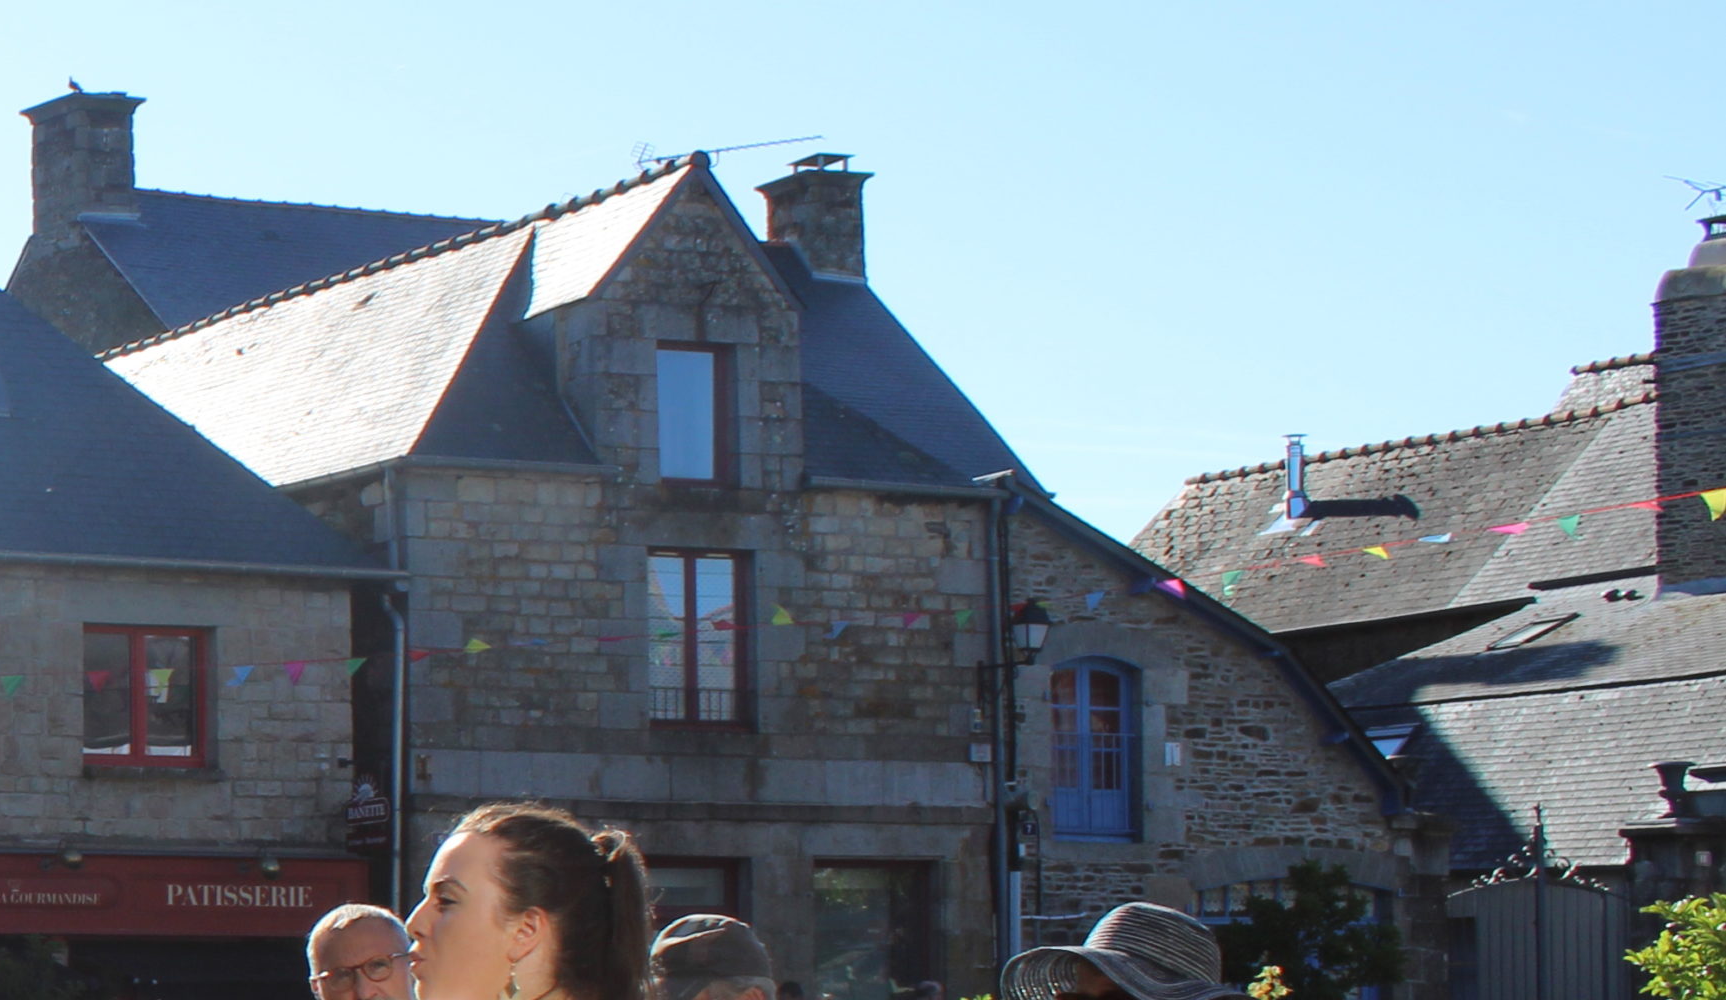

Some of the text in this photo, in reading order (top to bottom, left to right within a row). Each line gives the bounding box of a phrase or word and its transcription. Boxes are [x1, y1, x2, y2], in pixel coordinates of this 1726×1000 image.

[347, 804, 386, 820] BANETTE
[9, 892, 101, 905] GOURMANDISE
[166, 884, 314, 908] PATISSERIE
